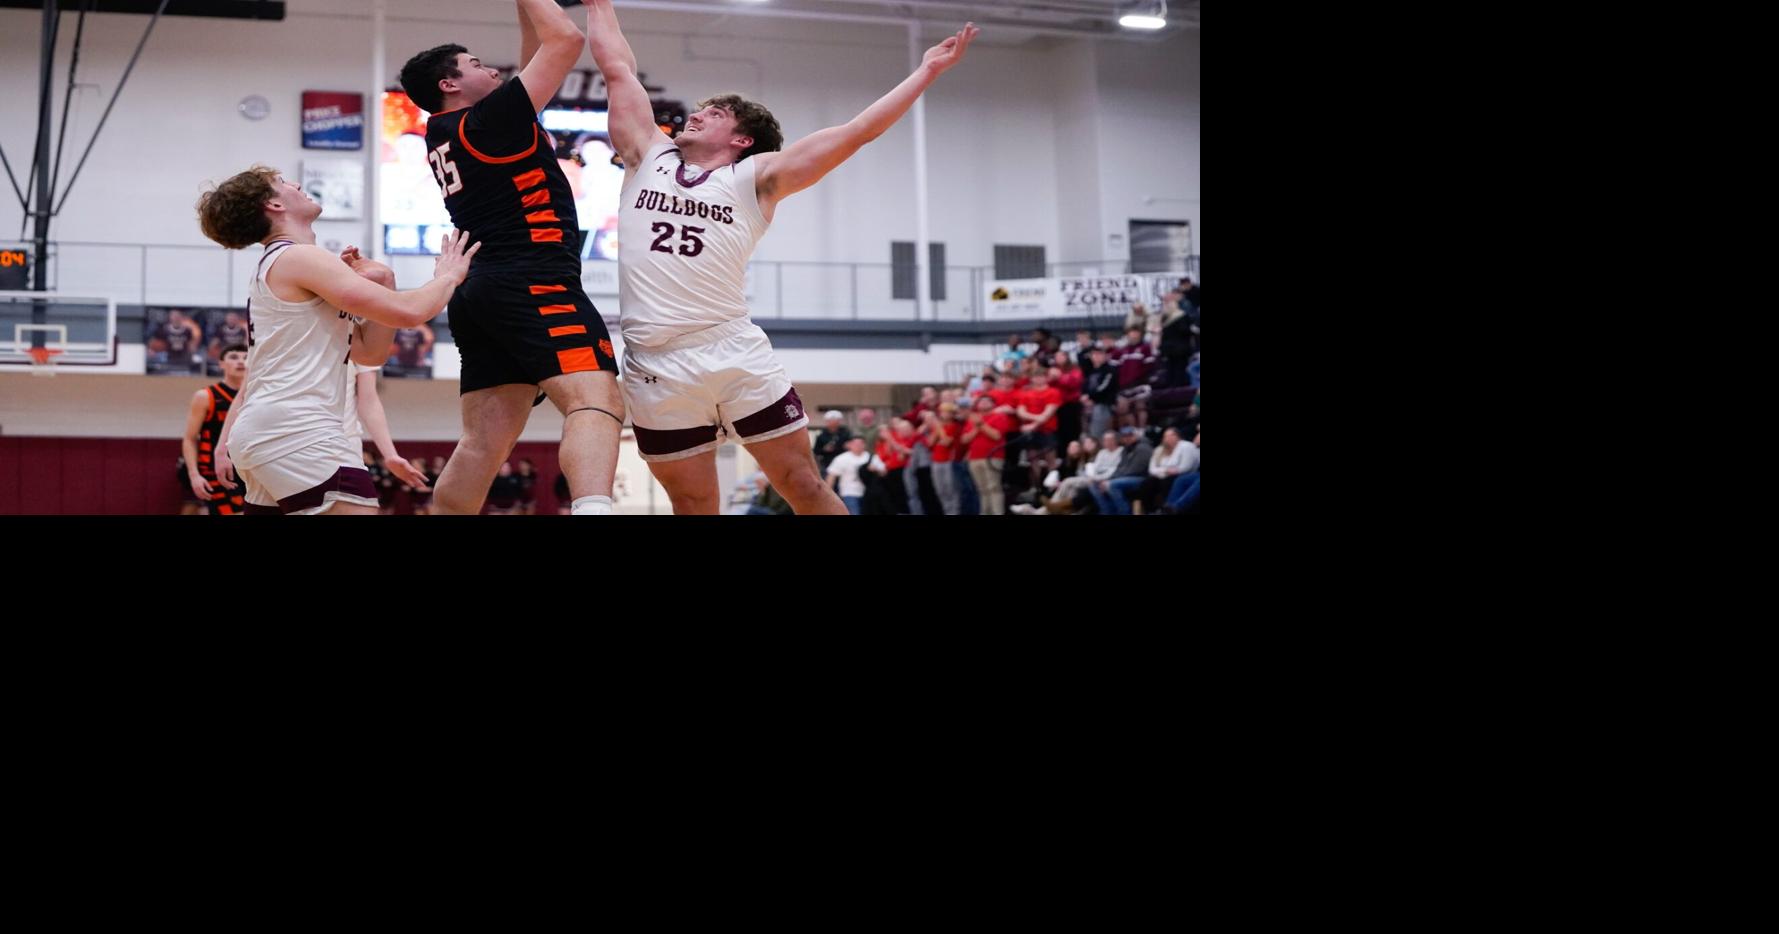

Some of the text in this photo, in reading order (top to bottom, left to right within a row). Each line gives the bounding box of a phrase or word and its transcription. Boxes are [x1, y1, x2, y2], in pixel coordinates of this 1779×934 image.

[428, 141, 463, 198] 35
[634, 189, 734, 224] BULLDOGS
[650, 221, 706, 257] 25
[1060, 277, 1138, 292] FRIEND
[1066, 291, 1134, 307] ZONE
